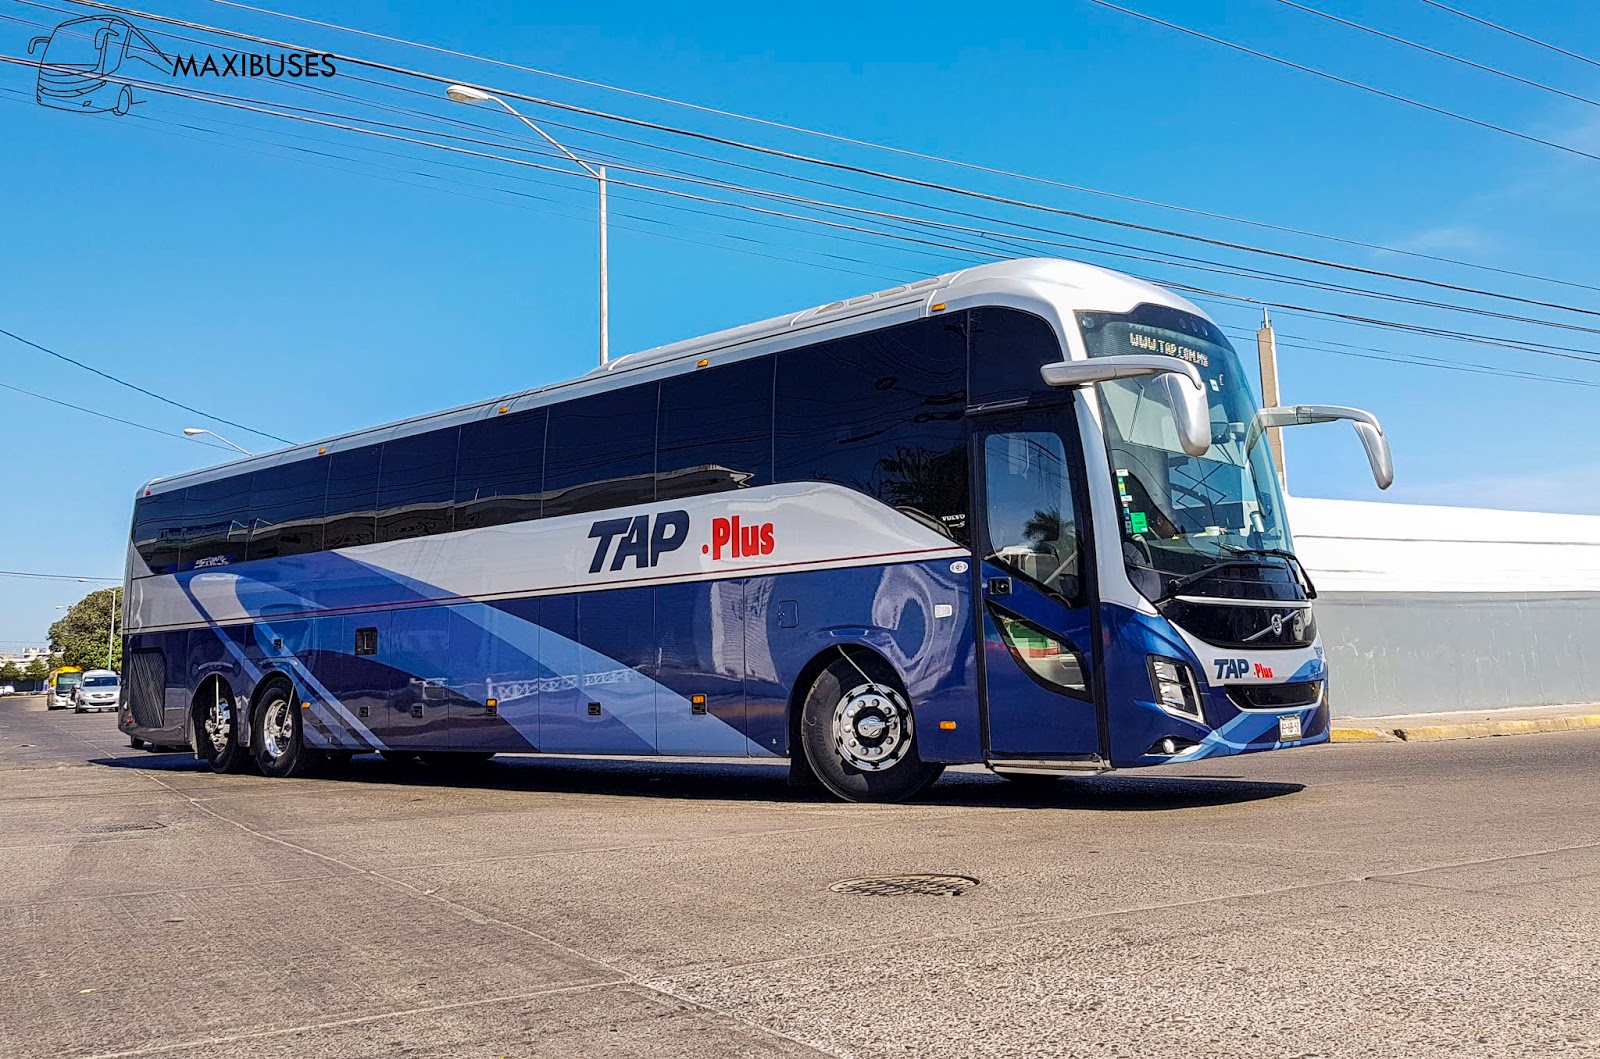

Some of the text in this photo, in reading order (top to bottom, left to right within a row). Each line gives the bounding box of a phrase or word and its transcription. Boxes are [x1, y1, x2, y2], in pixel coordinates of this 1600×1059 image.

[941, 513, 966, 521] VOLVO
[588, 510, 690, 573] TAP
[1214, 658, 1250, 679] TAP
